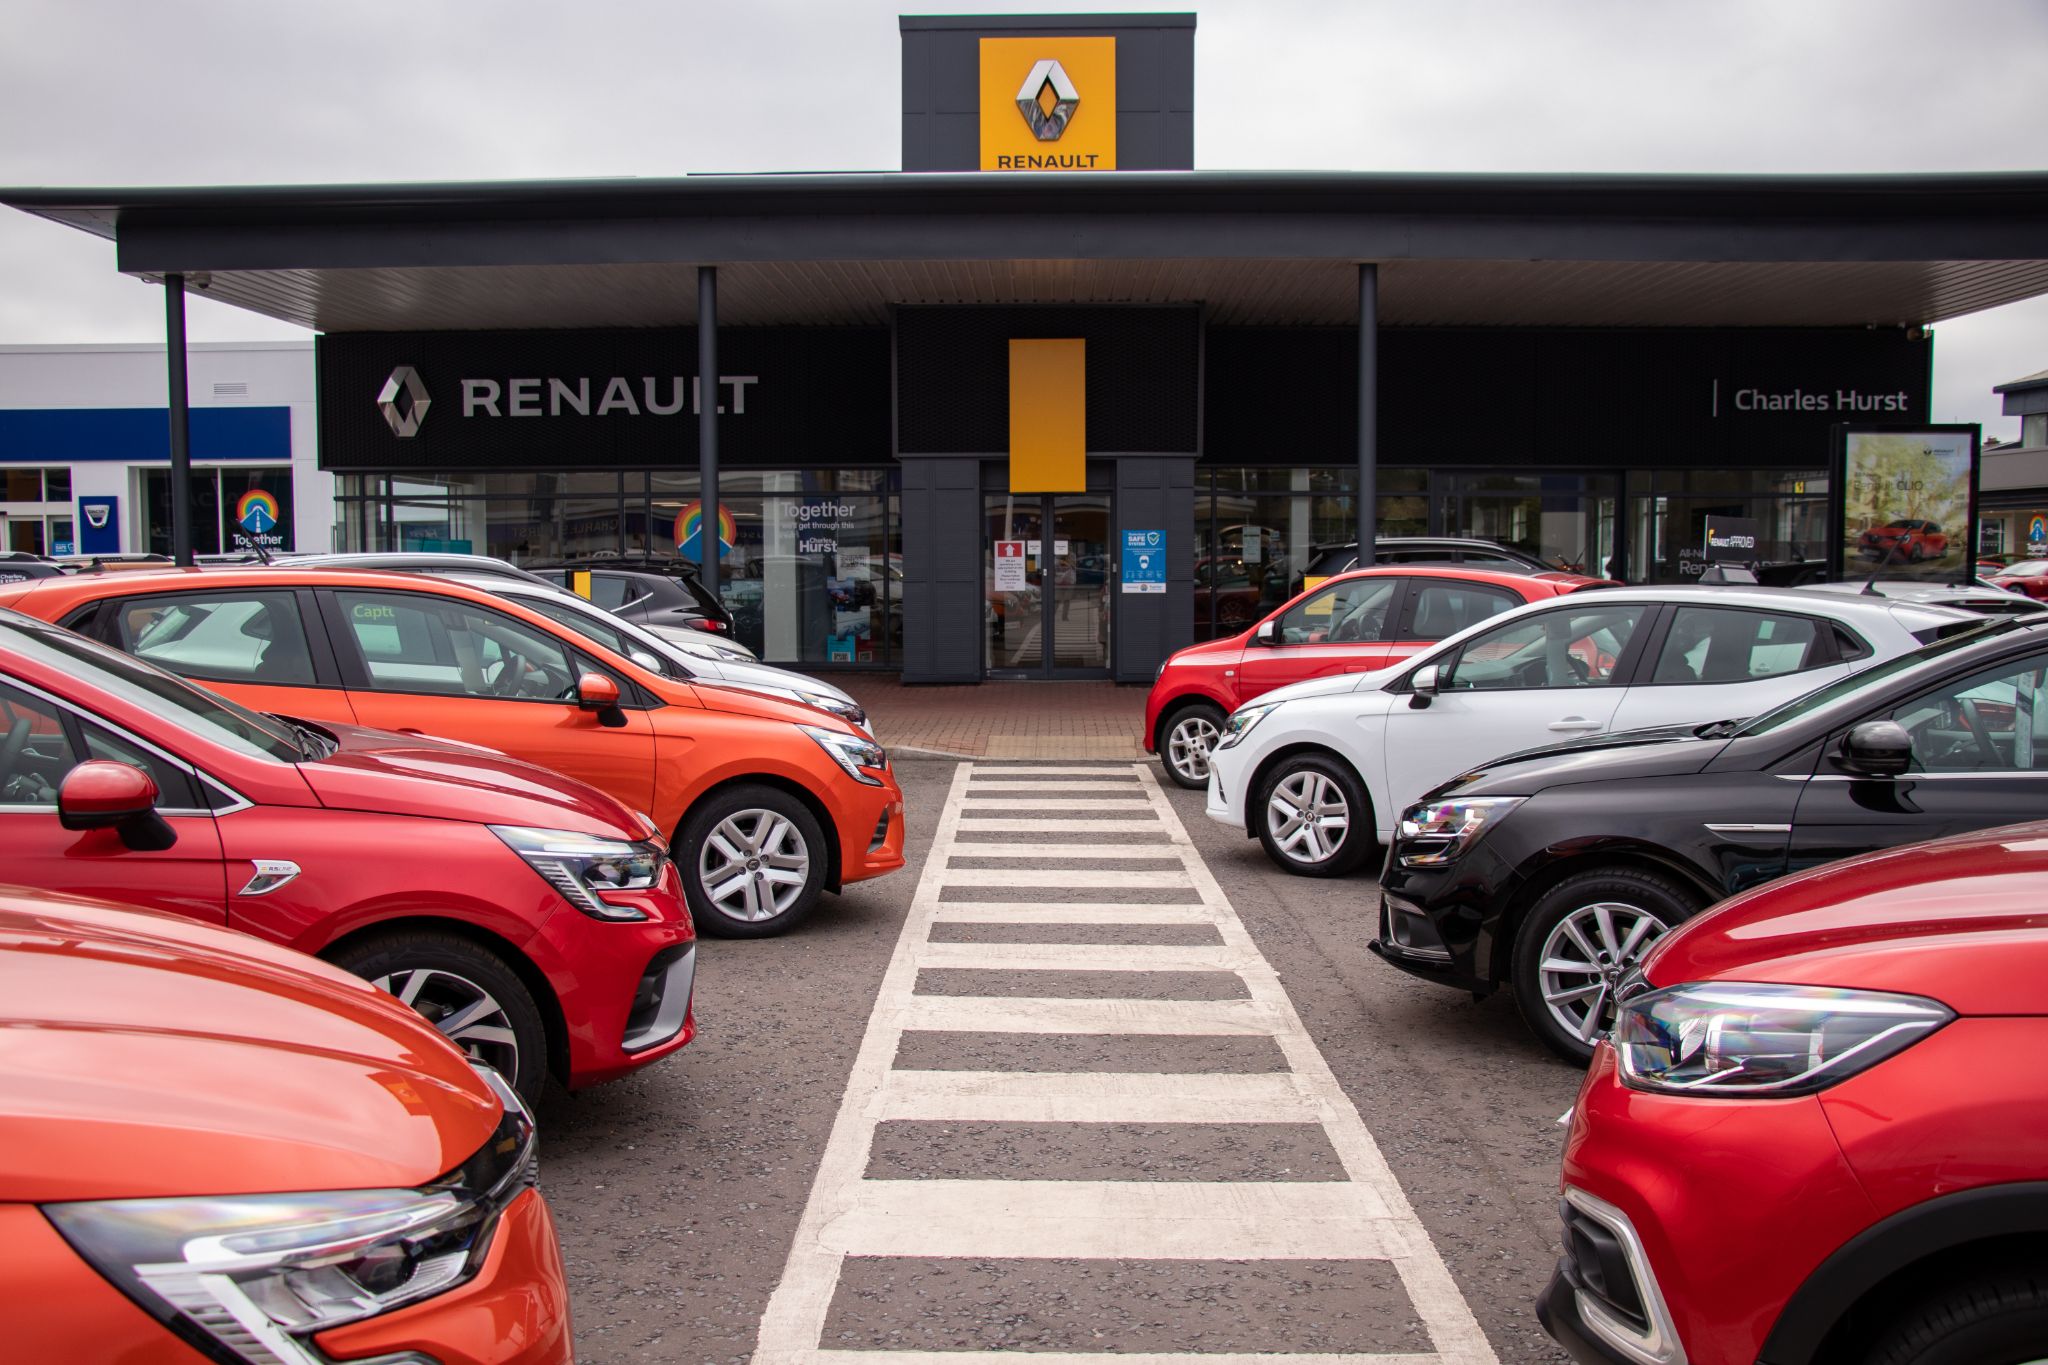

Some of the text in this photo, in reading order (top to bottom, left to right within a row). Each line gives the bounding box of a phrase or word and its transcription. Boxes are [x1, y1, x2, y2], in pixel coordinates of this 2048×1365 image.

[998, 154, 1099, 169] RENAULT
[460, 376, 759, 417] RENAULT
[1735, 389, 1908, 411] Charles Hurst
[1896, 480, 1924, 491] CLIO
[781, 501, 856, 521] Together
[798, 522, 811, 531] get
[812, 522, 840, 530] through
[233, 533, 283, 548] Together
[799, 540, 838, 553] Hurst
[1679, 548, 1704, 558] All-N
[353, 604, 395, 620] Capt
